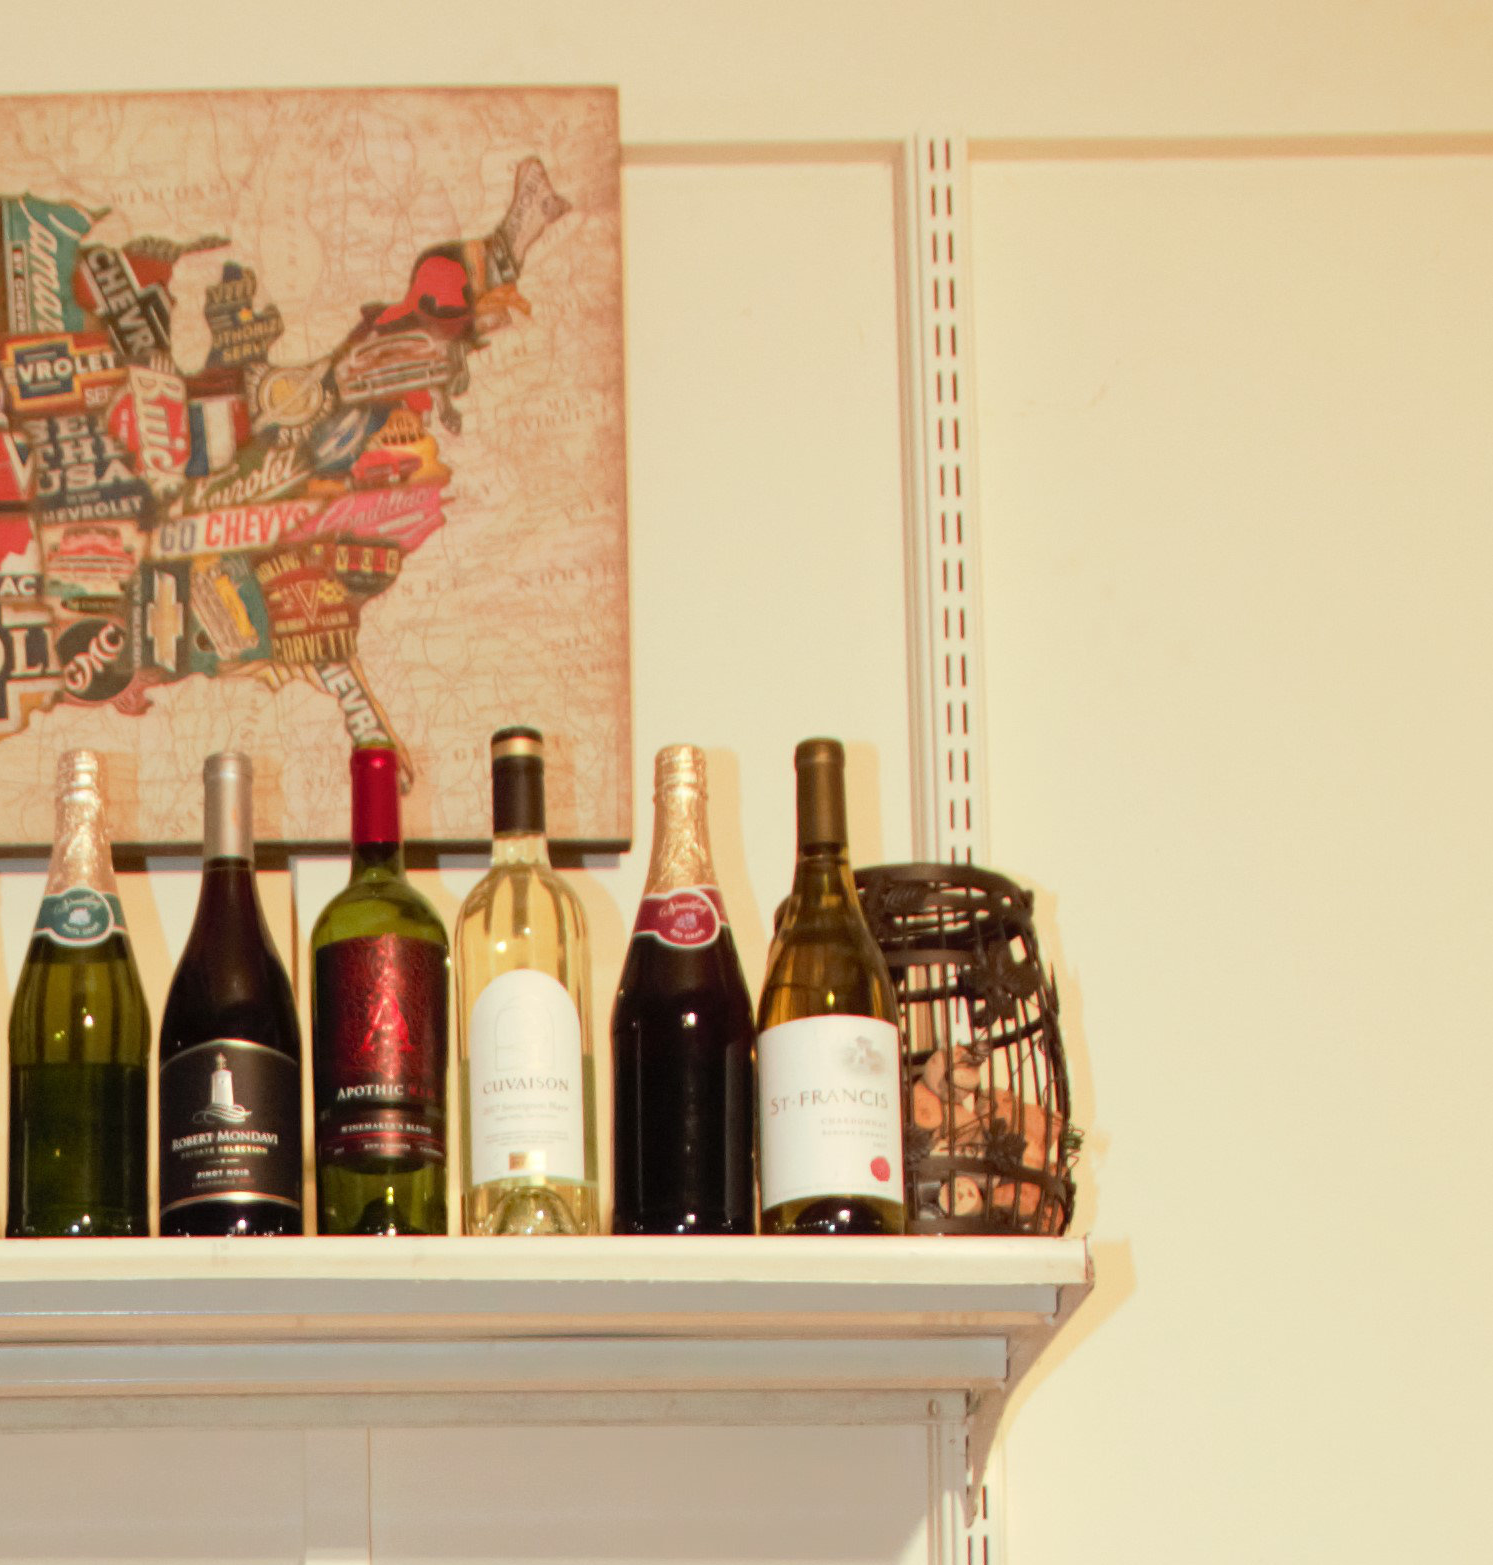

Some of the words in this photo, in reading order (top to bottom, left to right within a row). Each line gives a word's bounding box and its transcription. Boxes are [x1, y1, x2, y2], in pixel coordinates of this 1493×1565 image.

[64, 622, 124, 693] GMC
[337, 1084, 404, 1101] APOTHIC
[483, 1076, 570, 1096] CUVAISON
[799, 1088, 889, 1110] FRANCIS
[171, 1132, 214, 1152] ROBERT
[216, 1129, 279, 1145] MONDAVI
